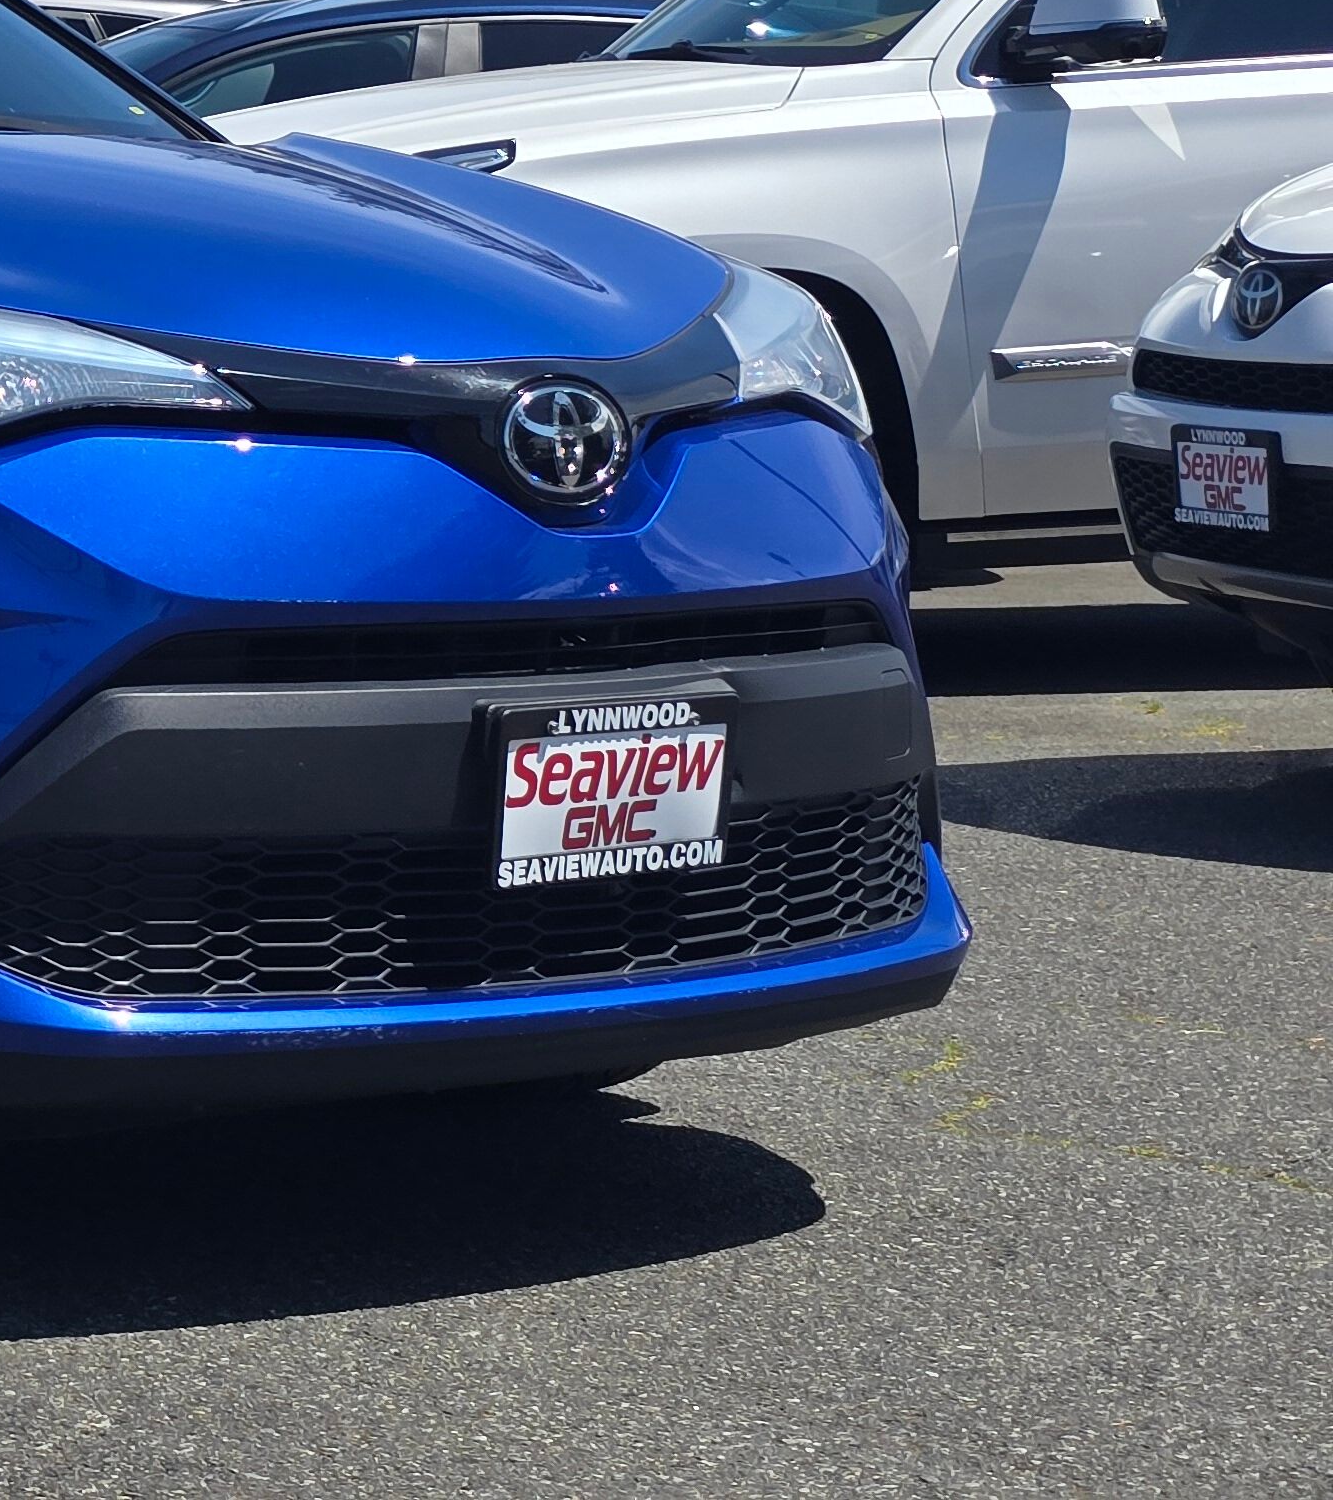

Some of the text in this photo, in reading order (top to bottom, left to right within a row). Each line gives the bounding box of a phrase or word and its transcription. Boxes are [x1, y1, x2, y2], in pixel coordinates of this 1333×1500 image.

[1190, 428, 1247, 446] LYNNWOOD
[1180, 445, 1268, 486] Seaview
[1204, 484, 1247, 512] GMC
[1174, 507, 1270, 532] SEAVIEWAUTO.COM
[557, 701, 692, 735] LYNNWOOD
[505, 733, 725, 809] Seaview
[561, 798, 658, 850] GMC
[497, 839, 724, 888] SEAVIEWAUTO.COM
